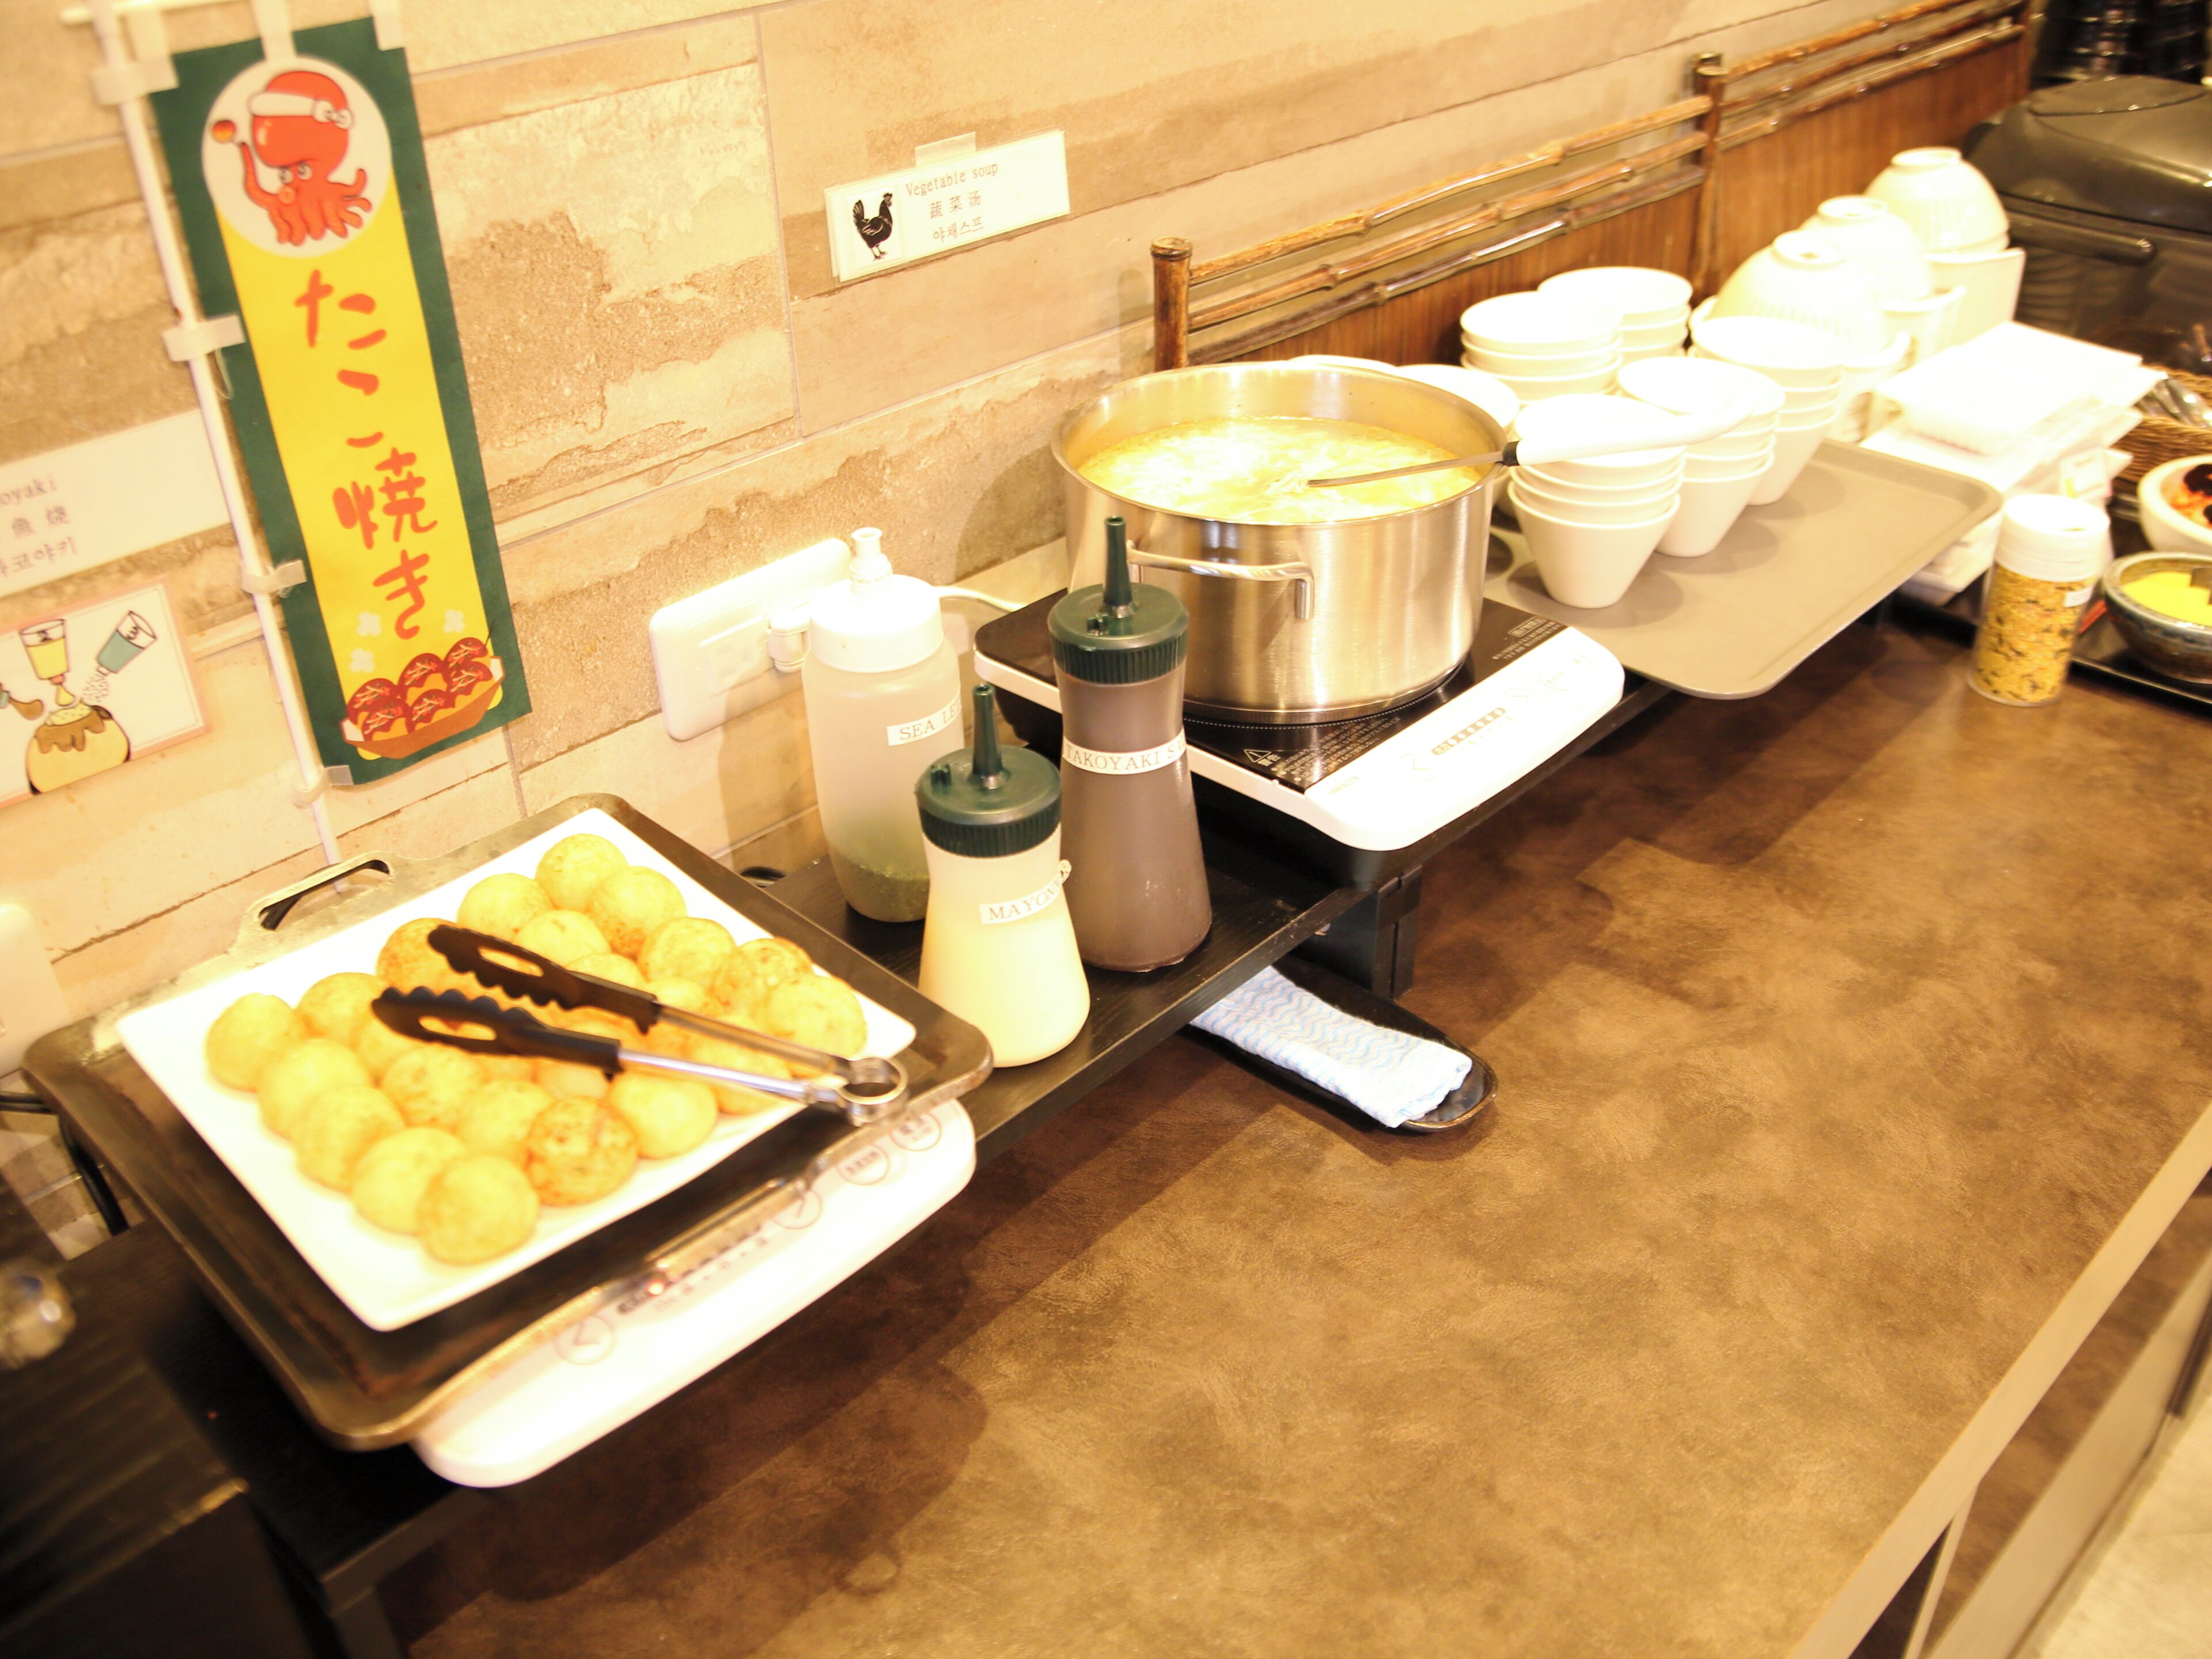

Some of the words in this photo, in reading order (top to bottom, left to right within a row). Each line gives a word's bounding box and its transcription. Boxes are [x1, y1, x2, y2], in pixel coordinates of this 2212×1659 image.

[905, 171, 967, 196] Vegetable
[972, 163, 998, 180] soup
[928, 190, 982, 219] 蔬菜汤
[933, 217, 984, 243] 야채스프
[295, 269, 438, 640] たこ焼き
[0, 474, 58, 506] oyaki
[899, 719, 936, 740] SEA
[1065, 743, 1161, 770] TAKOYAKI
